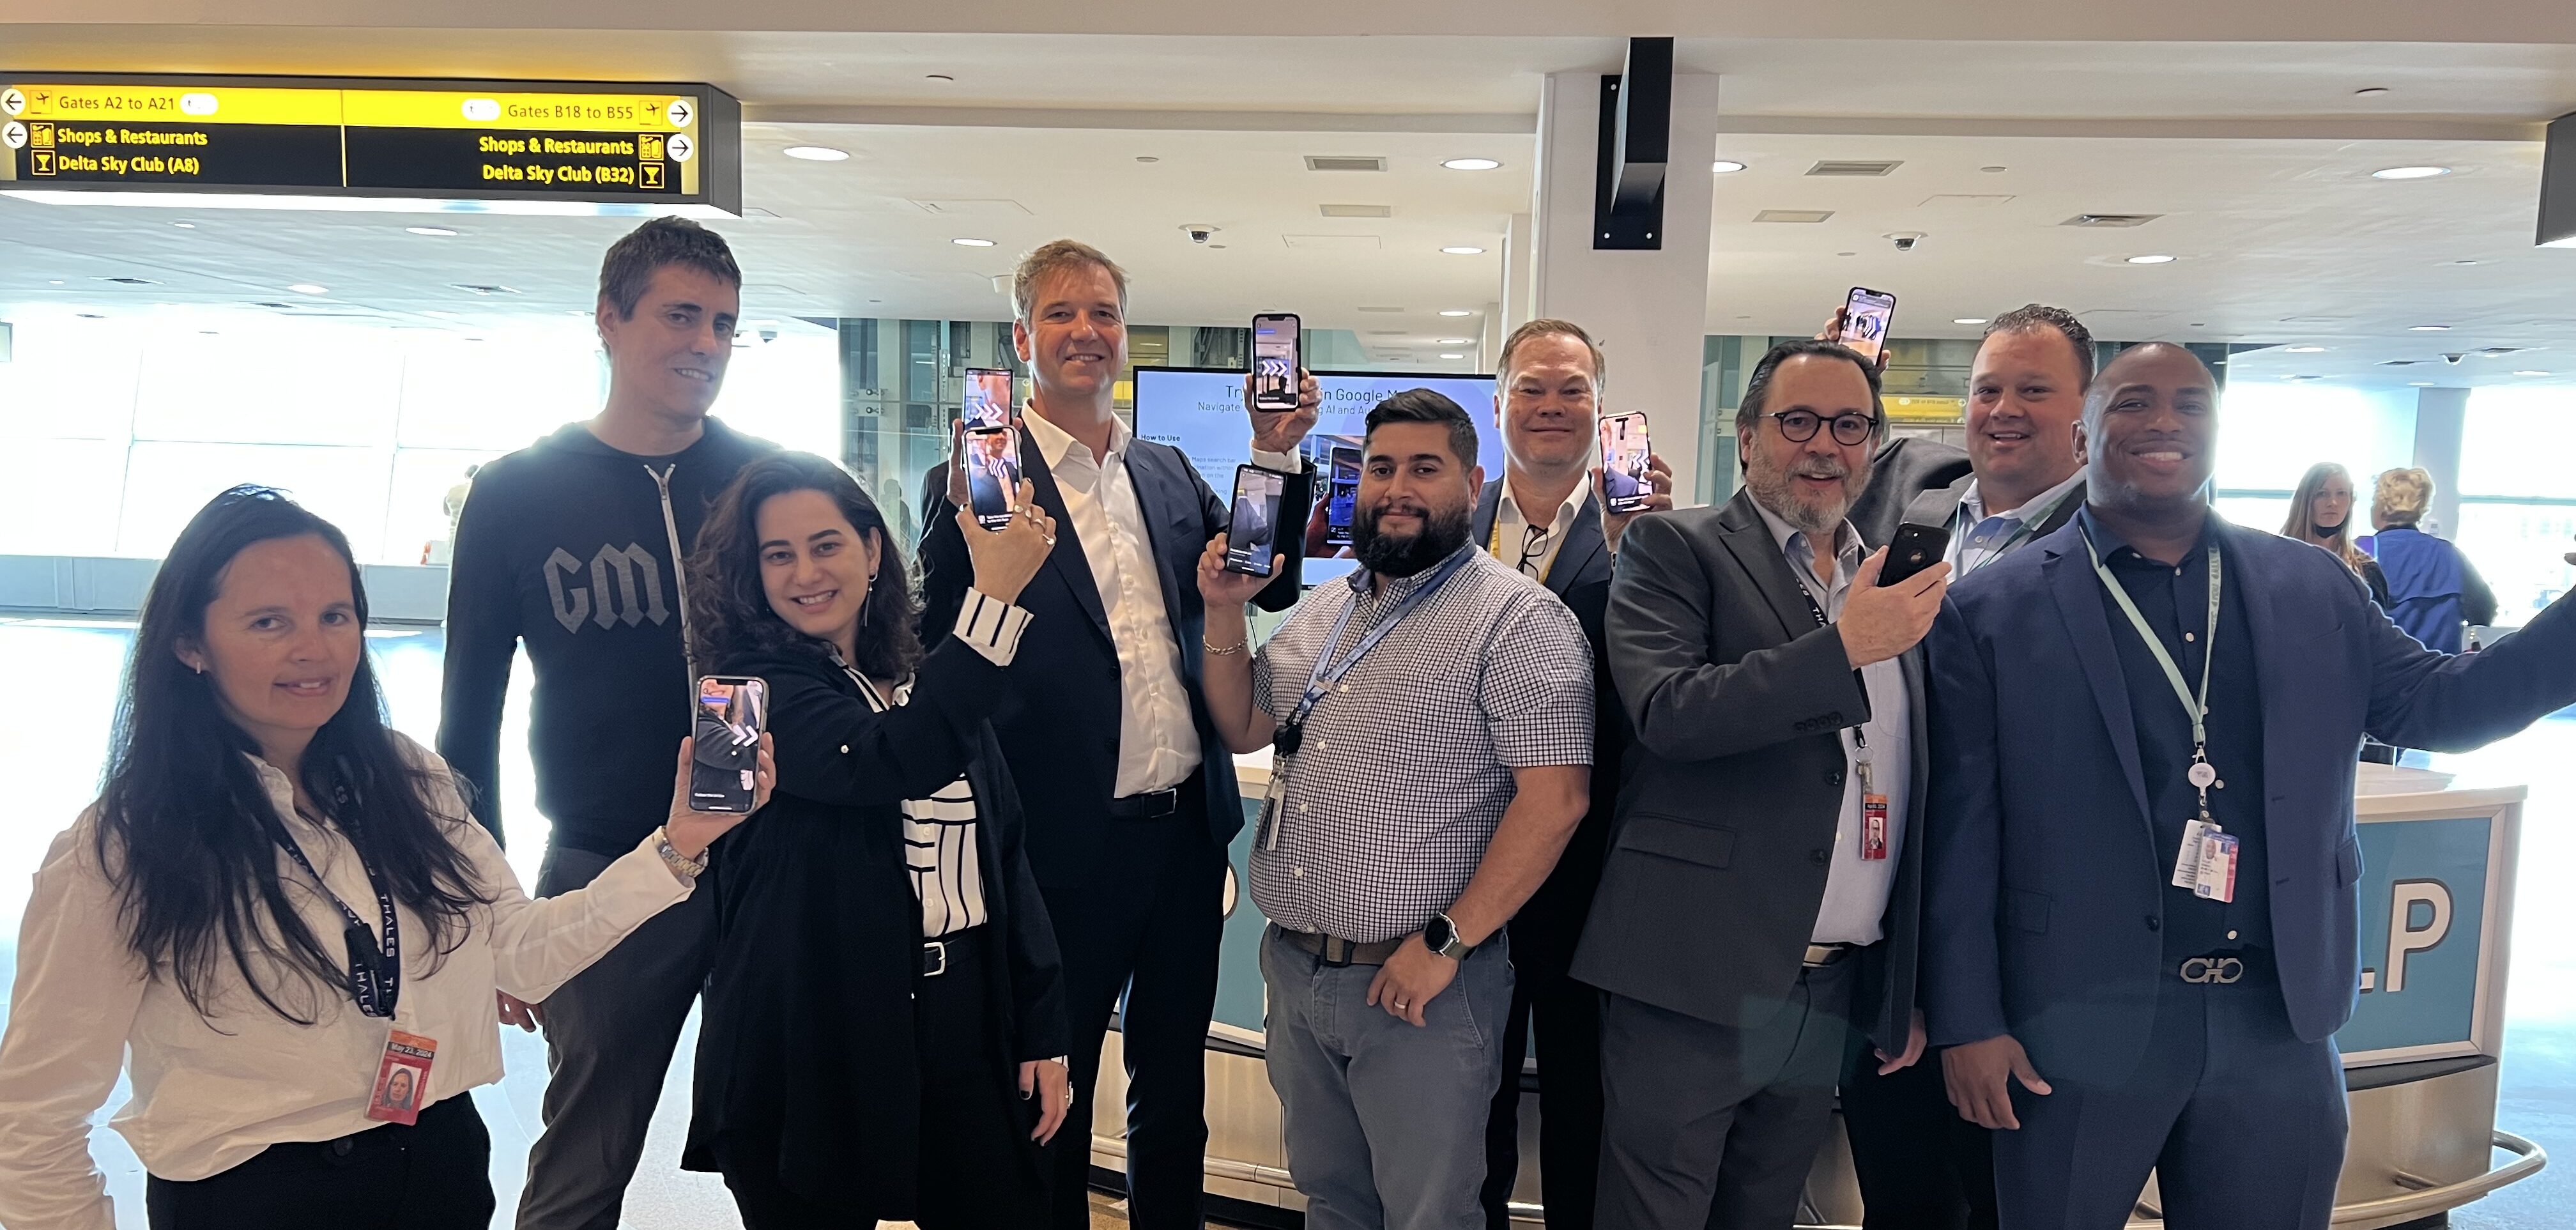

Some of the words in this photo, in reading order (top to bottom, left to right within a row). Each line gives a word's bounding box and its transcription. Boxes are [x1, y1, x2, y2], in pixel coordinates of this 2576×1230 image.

[59, 96, 99, 110] Gates
[104, 97, 123, 110] A2
[128, 98, 142, 110] to
[148, 98, 174, 111] A21
[508, 104, 549, 118] Gates
[555, 105, 581, 118] B18
[586, 106, 602, 119] to
[607, 106, 633, 120] B55
[57, 128, 103, 147] Shops
[105, 130, 118, 144] &
[120, 130, 208, 146] Restaurants
[480, 137, 525, 155] Shops
[529, 139, 541, 153] &
[544, 138, 634, 155] Restaurants
[59, 156, 98, 171] Delta
[102, 157, 128, 174] Sky
[132, 157, 164, 173] Club
[168, 157, 199, 175] (A8)
[482, 165, 523, 181] Delta
[526, 166, 555, 184] Sky
[557, 166, 592, 182] Club
[595, 166, 634, 184] (B32)
[1321, 387, 1331, 400] n
[1336, 388, 1383, 404] Google
[1198, 402, 1240, 413] Navigate
[1326, 405, 1335, 414] AI
[1338, 405, 1355, 414] and
[543, 542, 670, 634] GM
[380, 894, 395, 957] THALES
